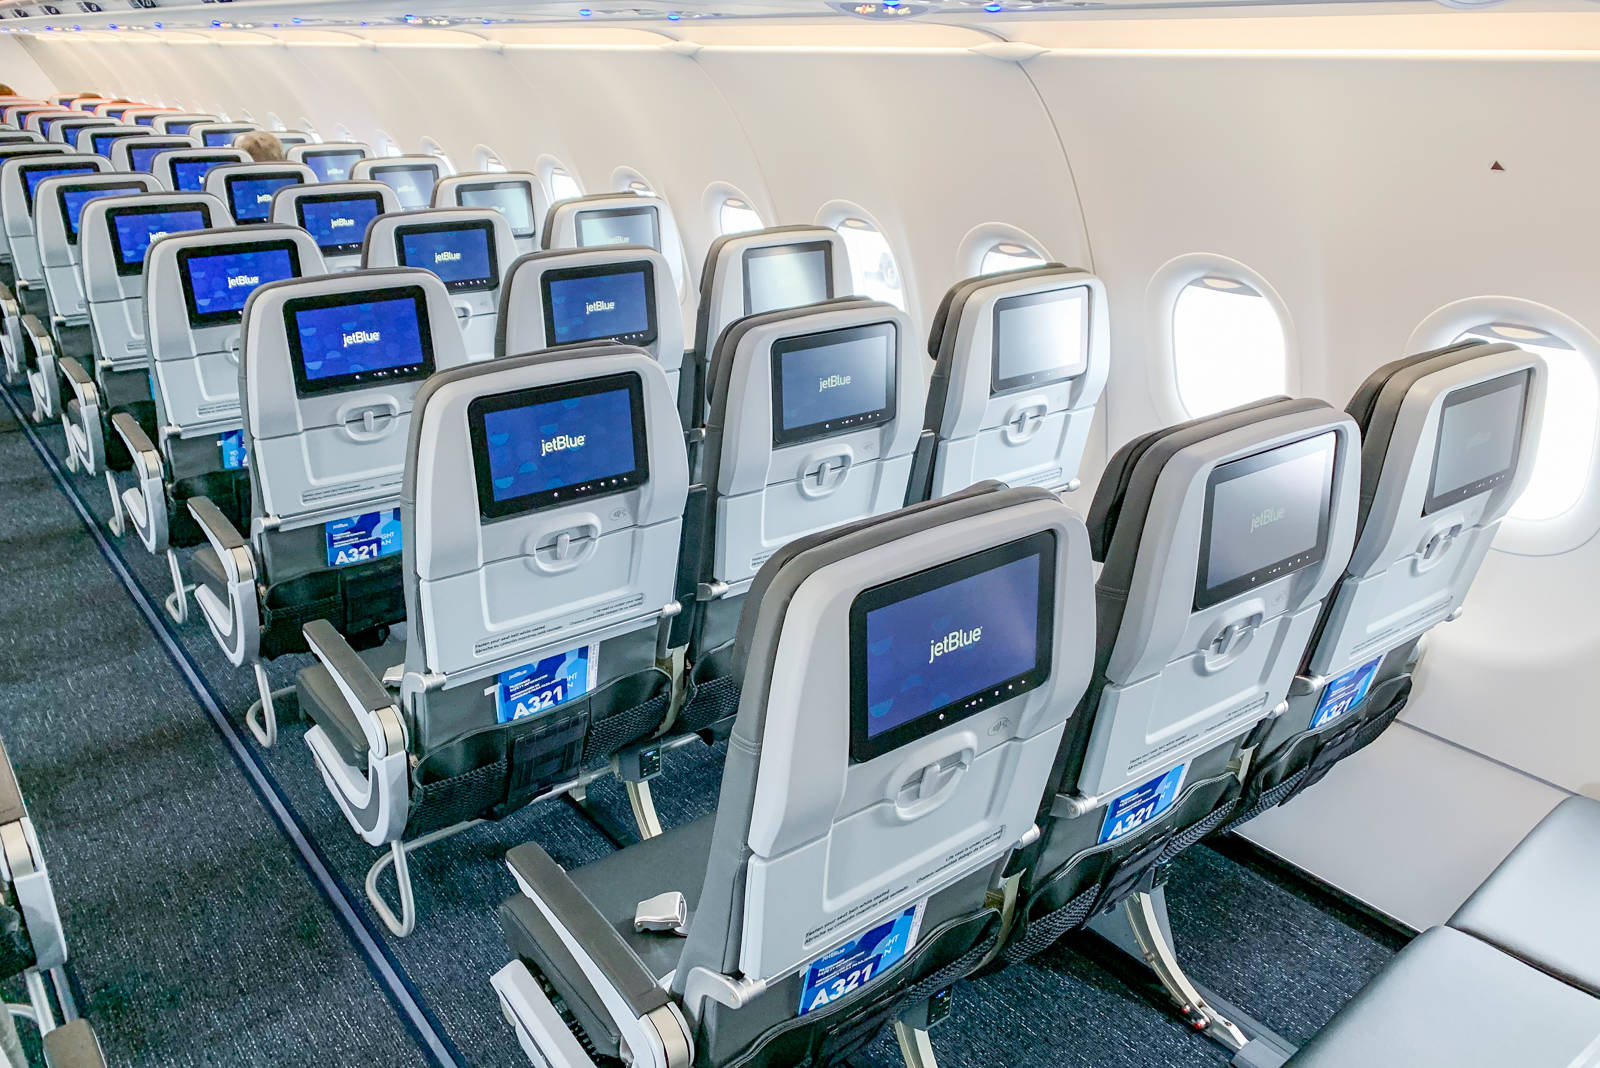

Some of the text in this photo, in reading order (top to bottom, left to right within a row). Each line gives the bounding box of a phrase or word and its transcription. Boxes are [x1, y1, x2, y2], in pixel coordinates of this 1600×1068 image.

[330, 217, 355, 230] jetBlue
[434, 251, 461, 264] jetBlue
[227, 275, 259, 289] jetBlue
[585, 300, 615, 315] jetBlue
[342, 330, 380, 348] jetBlue
[818, 373, 852, 393] jetBlue
[541, 434, 586, 457] jetBlue
[1249, 504, 1286, 534] jetBlue
[335, 542, 378, 565] A321
[928, 626, 983, 665] jetBlue
[513, 685, 563, 720] A321
[1107, 802, 1155, 841] A321
[808, 962, 874, 1012] A321
